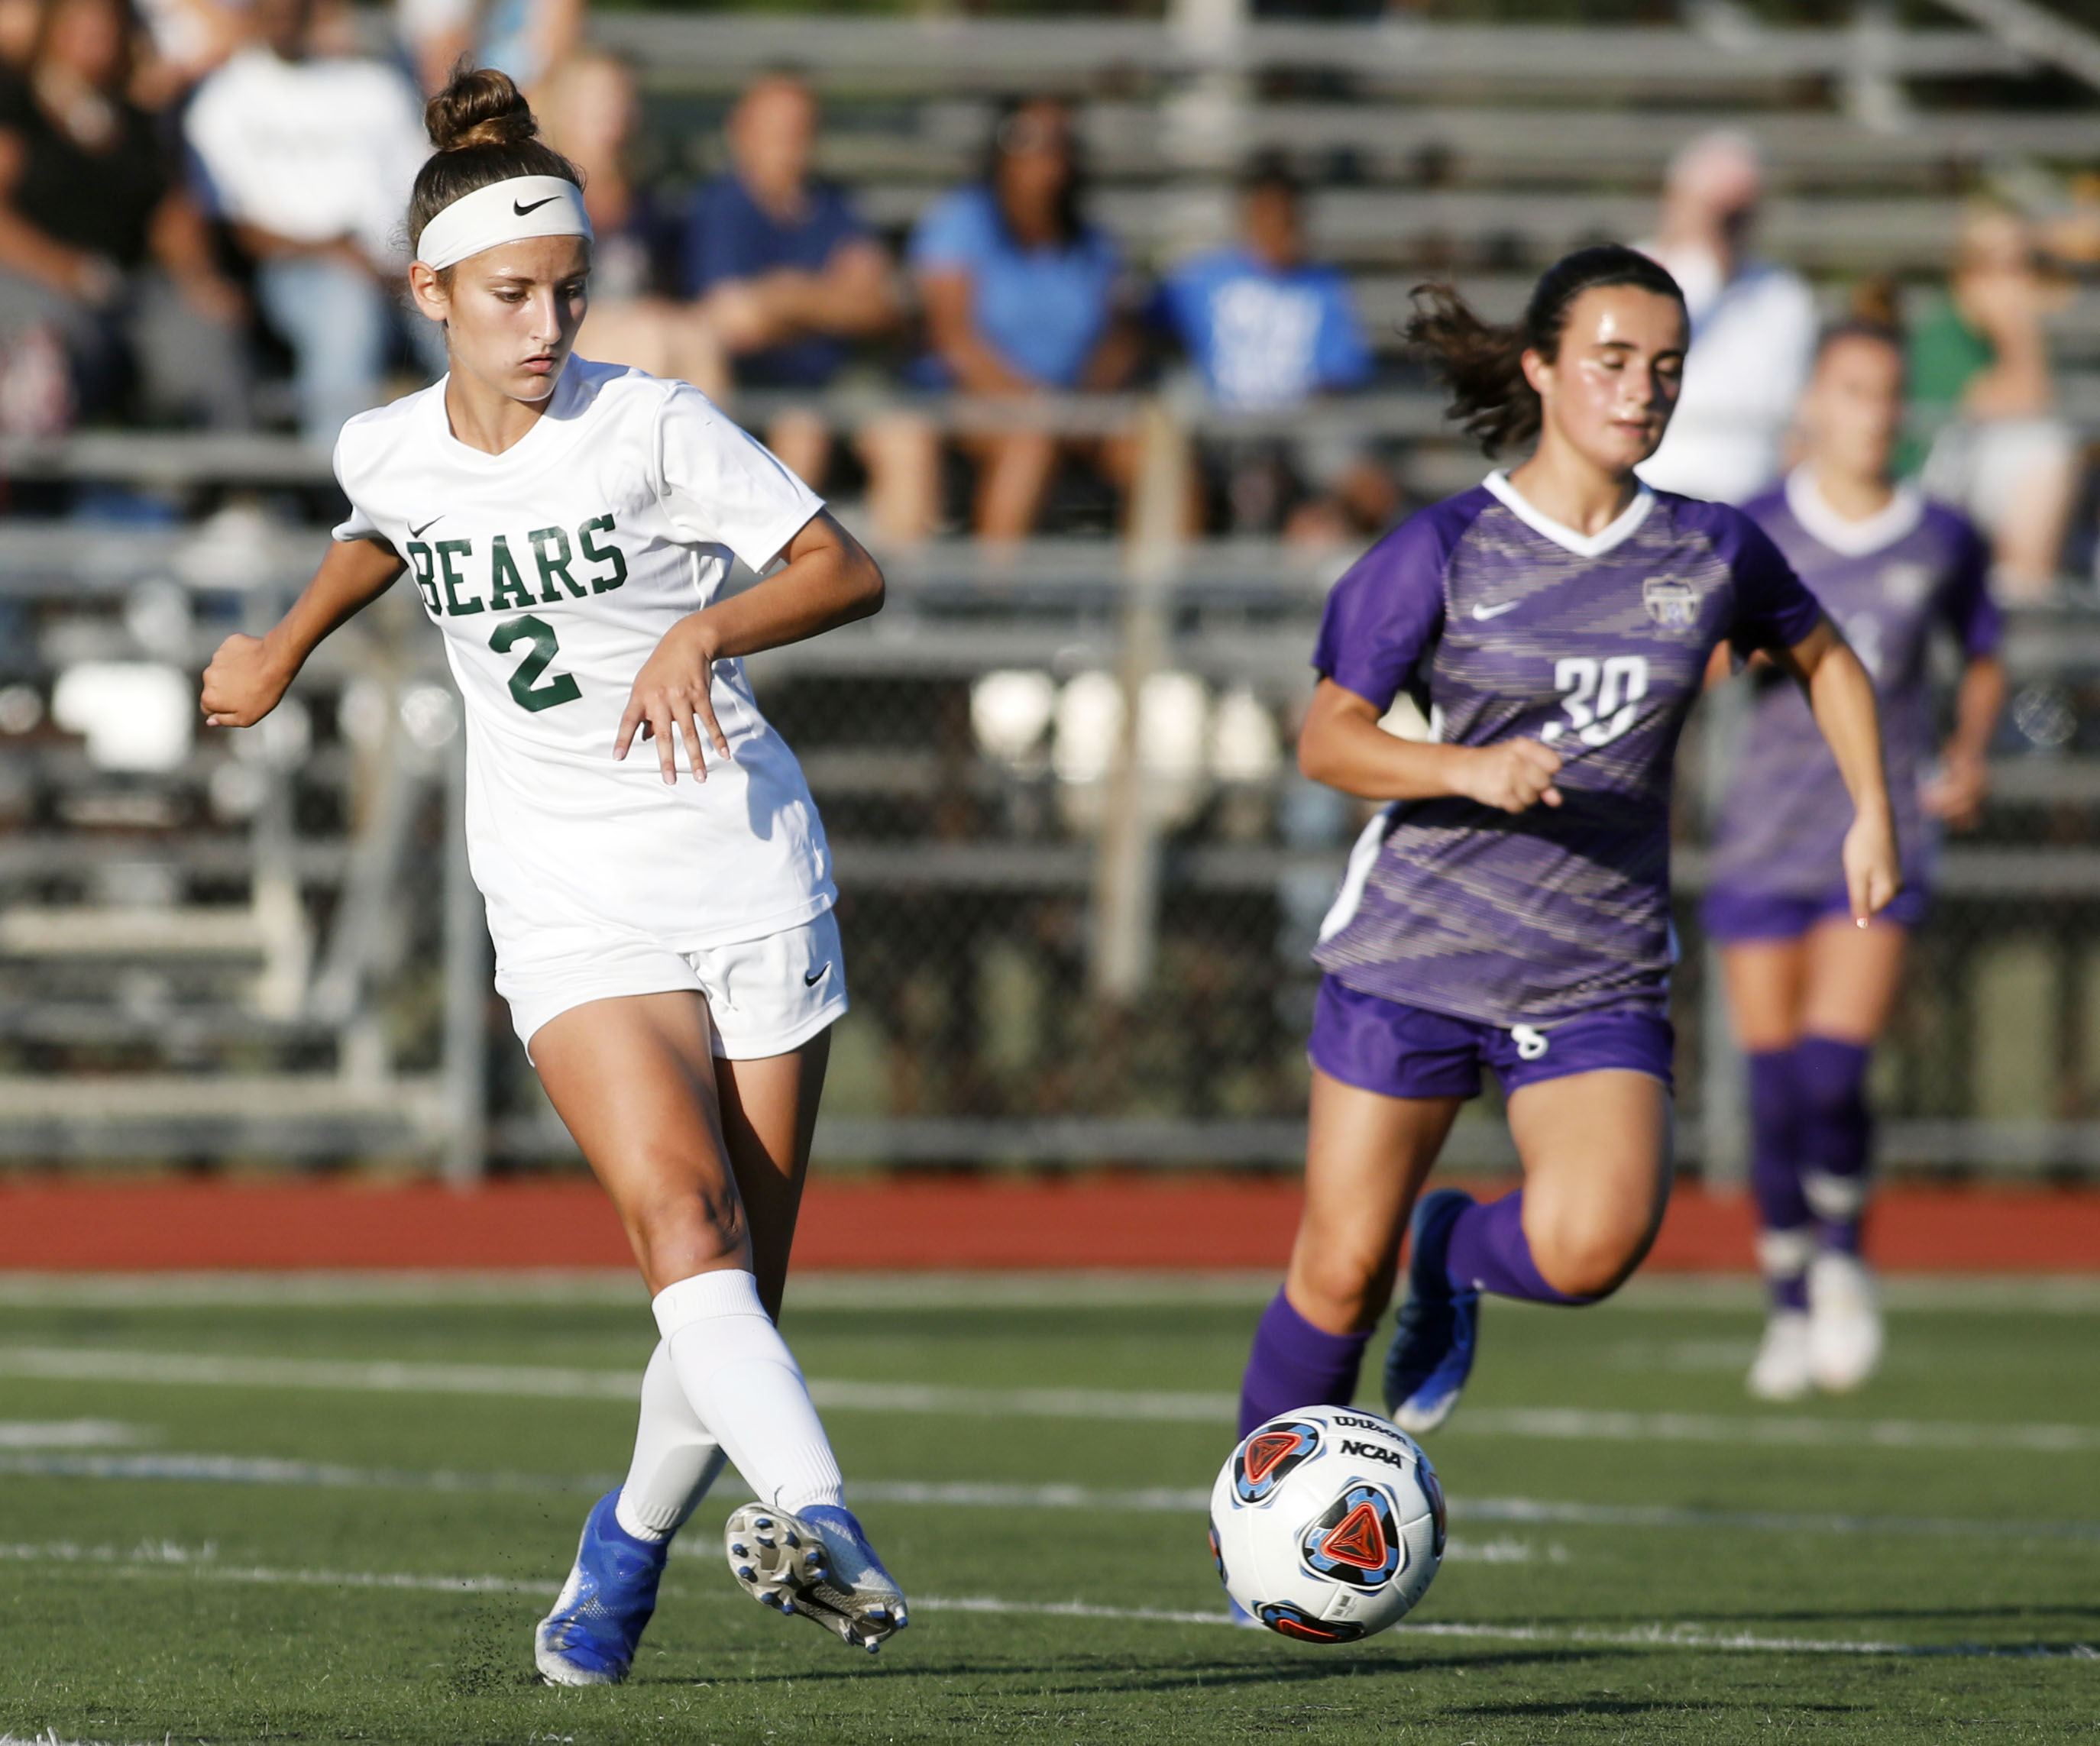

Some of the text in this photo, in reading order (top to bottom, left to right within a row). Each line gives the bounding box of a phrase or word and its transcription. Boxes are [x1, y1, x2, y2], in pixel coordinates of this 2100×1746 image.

[406, 512, 628, 616] BEARS
[487, 614, 583, 713] 2
[1541, 655, 1649, 747] 30
[1332, 1416, 1410, 1447] Wilson
[1340, 1439, 1402, 1470] NCAA
